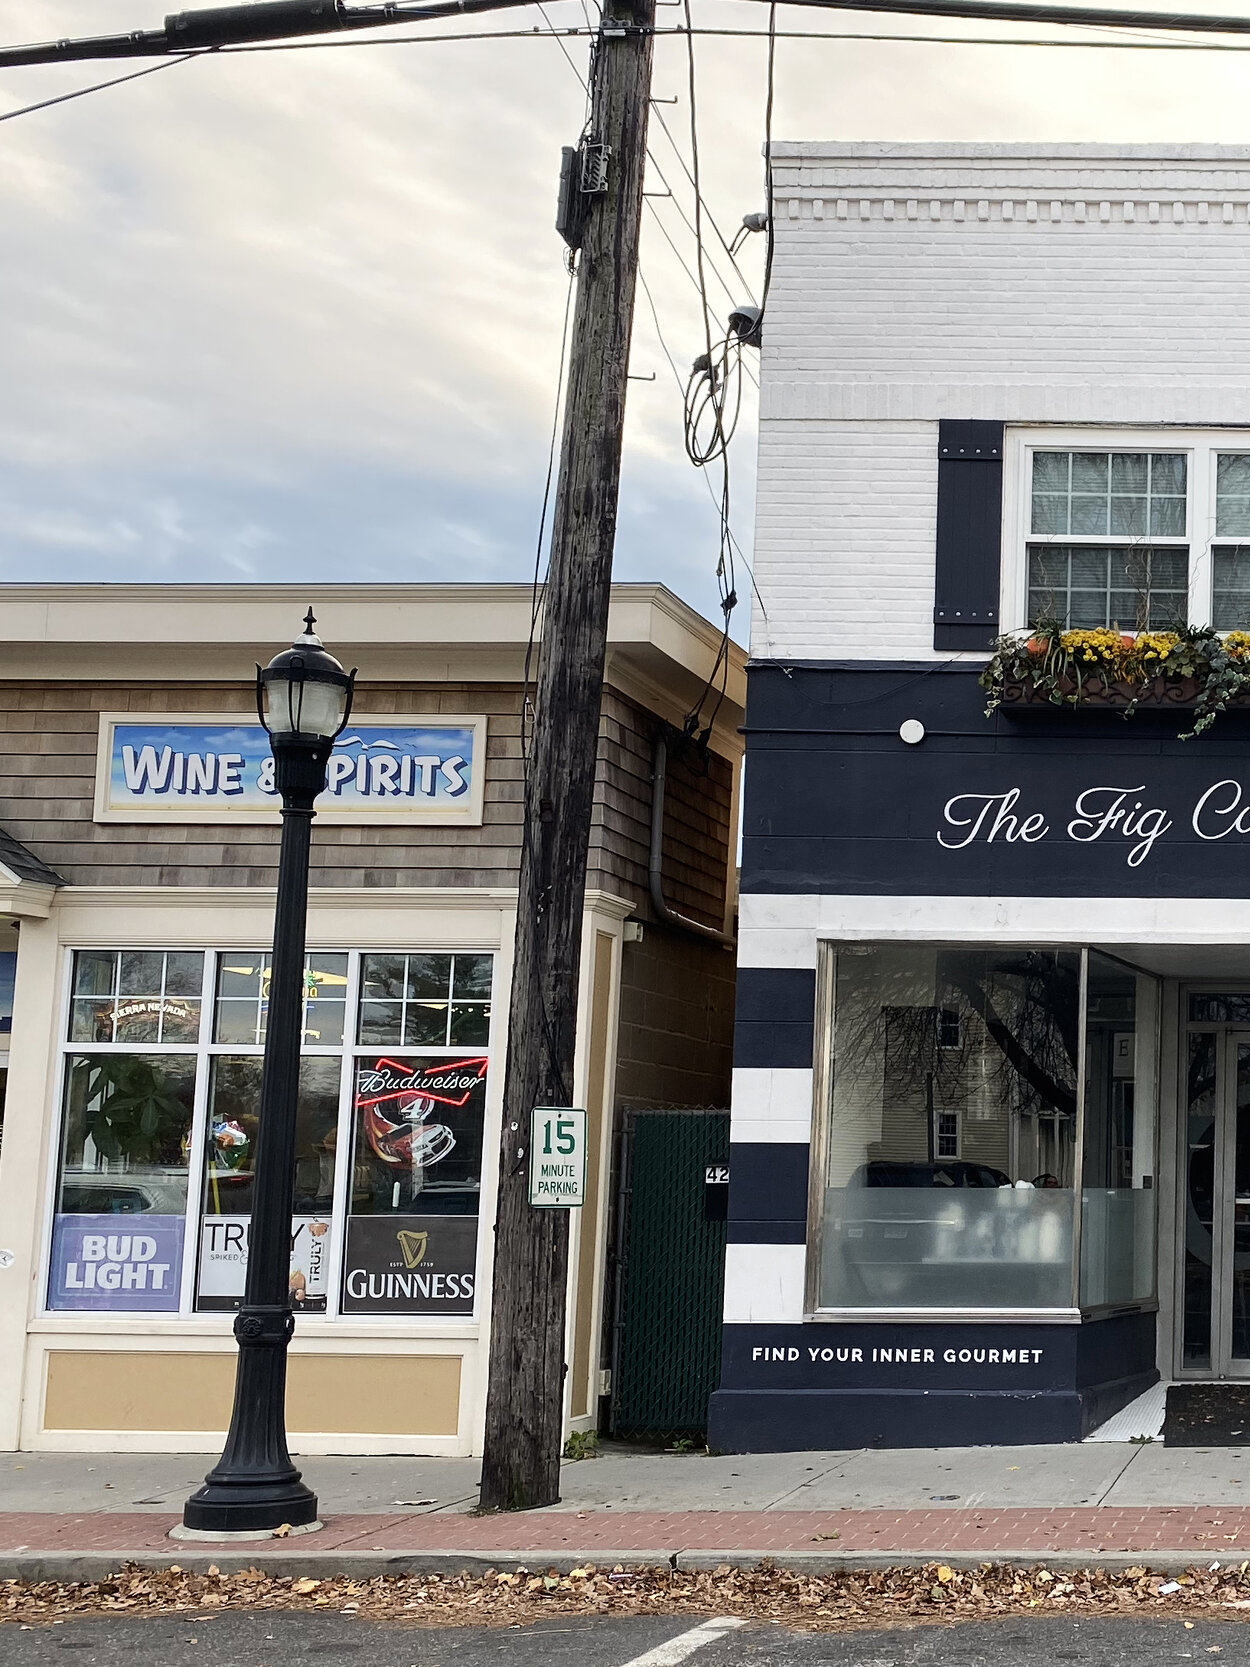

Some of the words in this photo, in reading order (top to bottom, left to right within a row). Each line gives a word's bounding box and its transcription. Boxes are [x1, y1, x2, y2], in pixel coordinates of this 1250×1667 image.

[122, 745, 245, 795] WINE
[325, 754, 469, 797] PIRITS
[937, 787, 1049, 849] The
[1067, 785, 1173, 867] Fig
[147, 1002, 187, 1018] NEVADA
[358, 1068, 485, 1092] Budweiser
[400, 1098, 424, 1119] 4
[542, 1120, 575, 1155] 15
[541, 1164, 575, 1177] MINUTE
[706, 1166, 729, 1182] 42
[538, 1181, 578, 1194] PARKING
[82, 1235, 157, 1262] BUD
[210, 1253, 239, 1261] SPIKED
[309, 1238, 322, 1284] TRULY
[65, 1262, 170, 1290] LIGHT
[346, 1268, 474, 1299] GUINNESS
[752, 1347, 800, 1361] FIND
[808, 1347, 864, 1362] YOUR
[872, 1348, 935, 1363] INNER
[943, 1349, 1043, 1363] GOURMET
